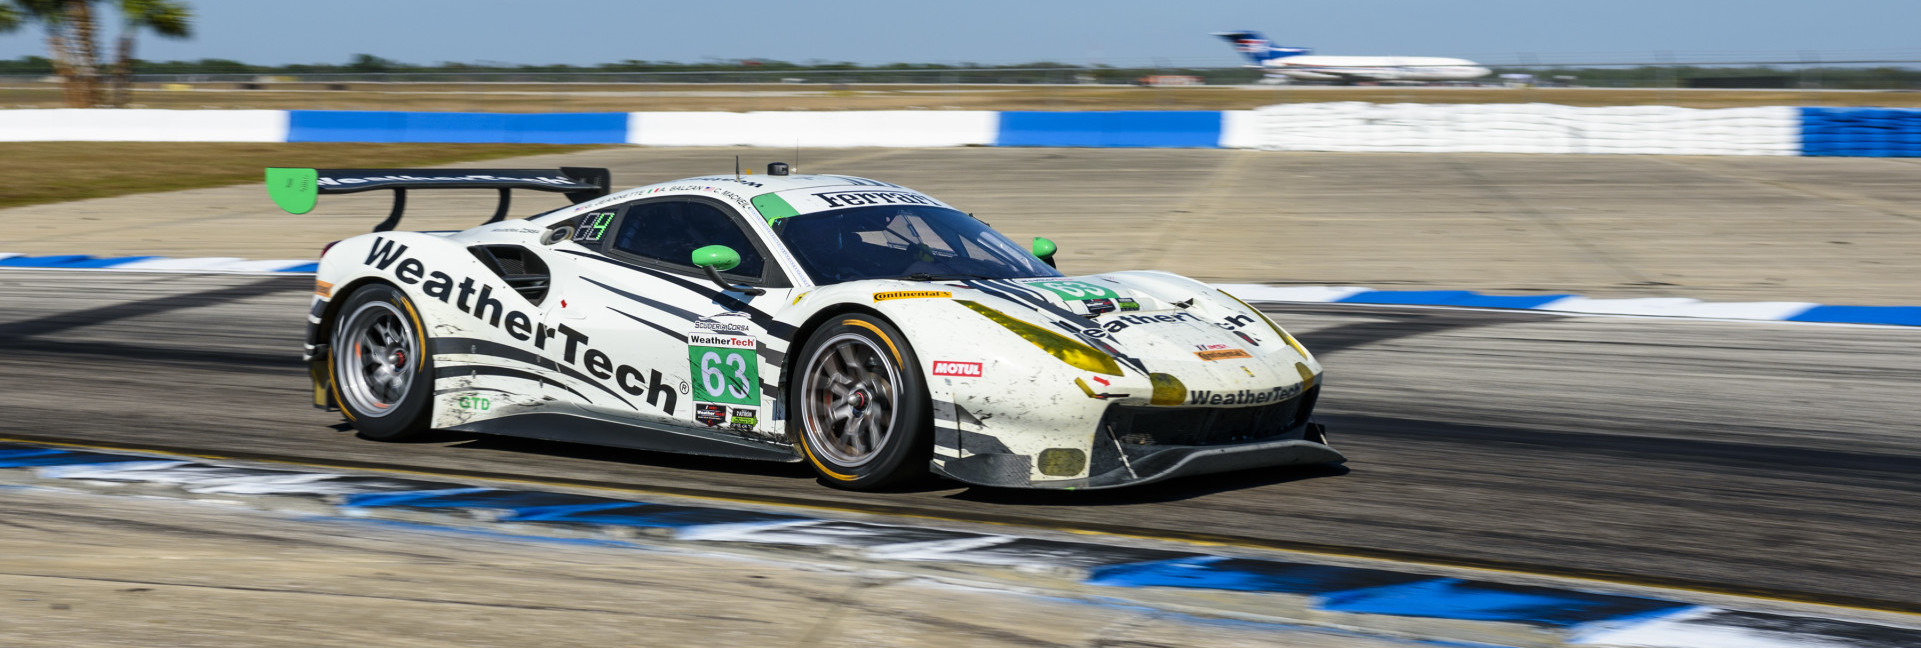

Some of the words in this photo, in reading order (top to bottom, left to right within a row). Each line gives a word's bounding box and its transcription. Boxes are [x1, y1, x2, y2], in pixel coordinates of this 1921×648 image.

[811, 190, 942, 208] Ferrari
[874, 291, 940, 300] Continental
[1043, 281, 1106, 298] 63
[691, 335, 754, 347] WeatherTech
[701, 351, 750, 399] 63
[935, 362, 981, 375] MOTUL
[1190, 381, 1304, 405] WeatherTech
[459, 396, 490, 410] GTD
